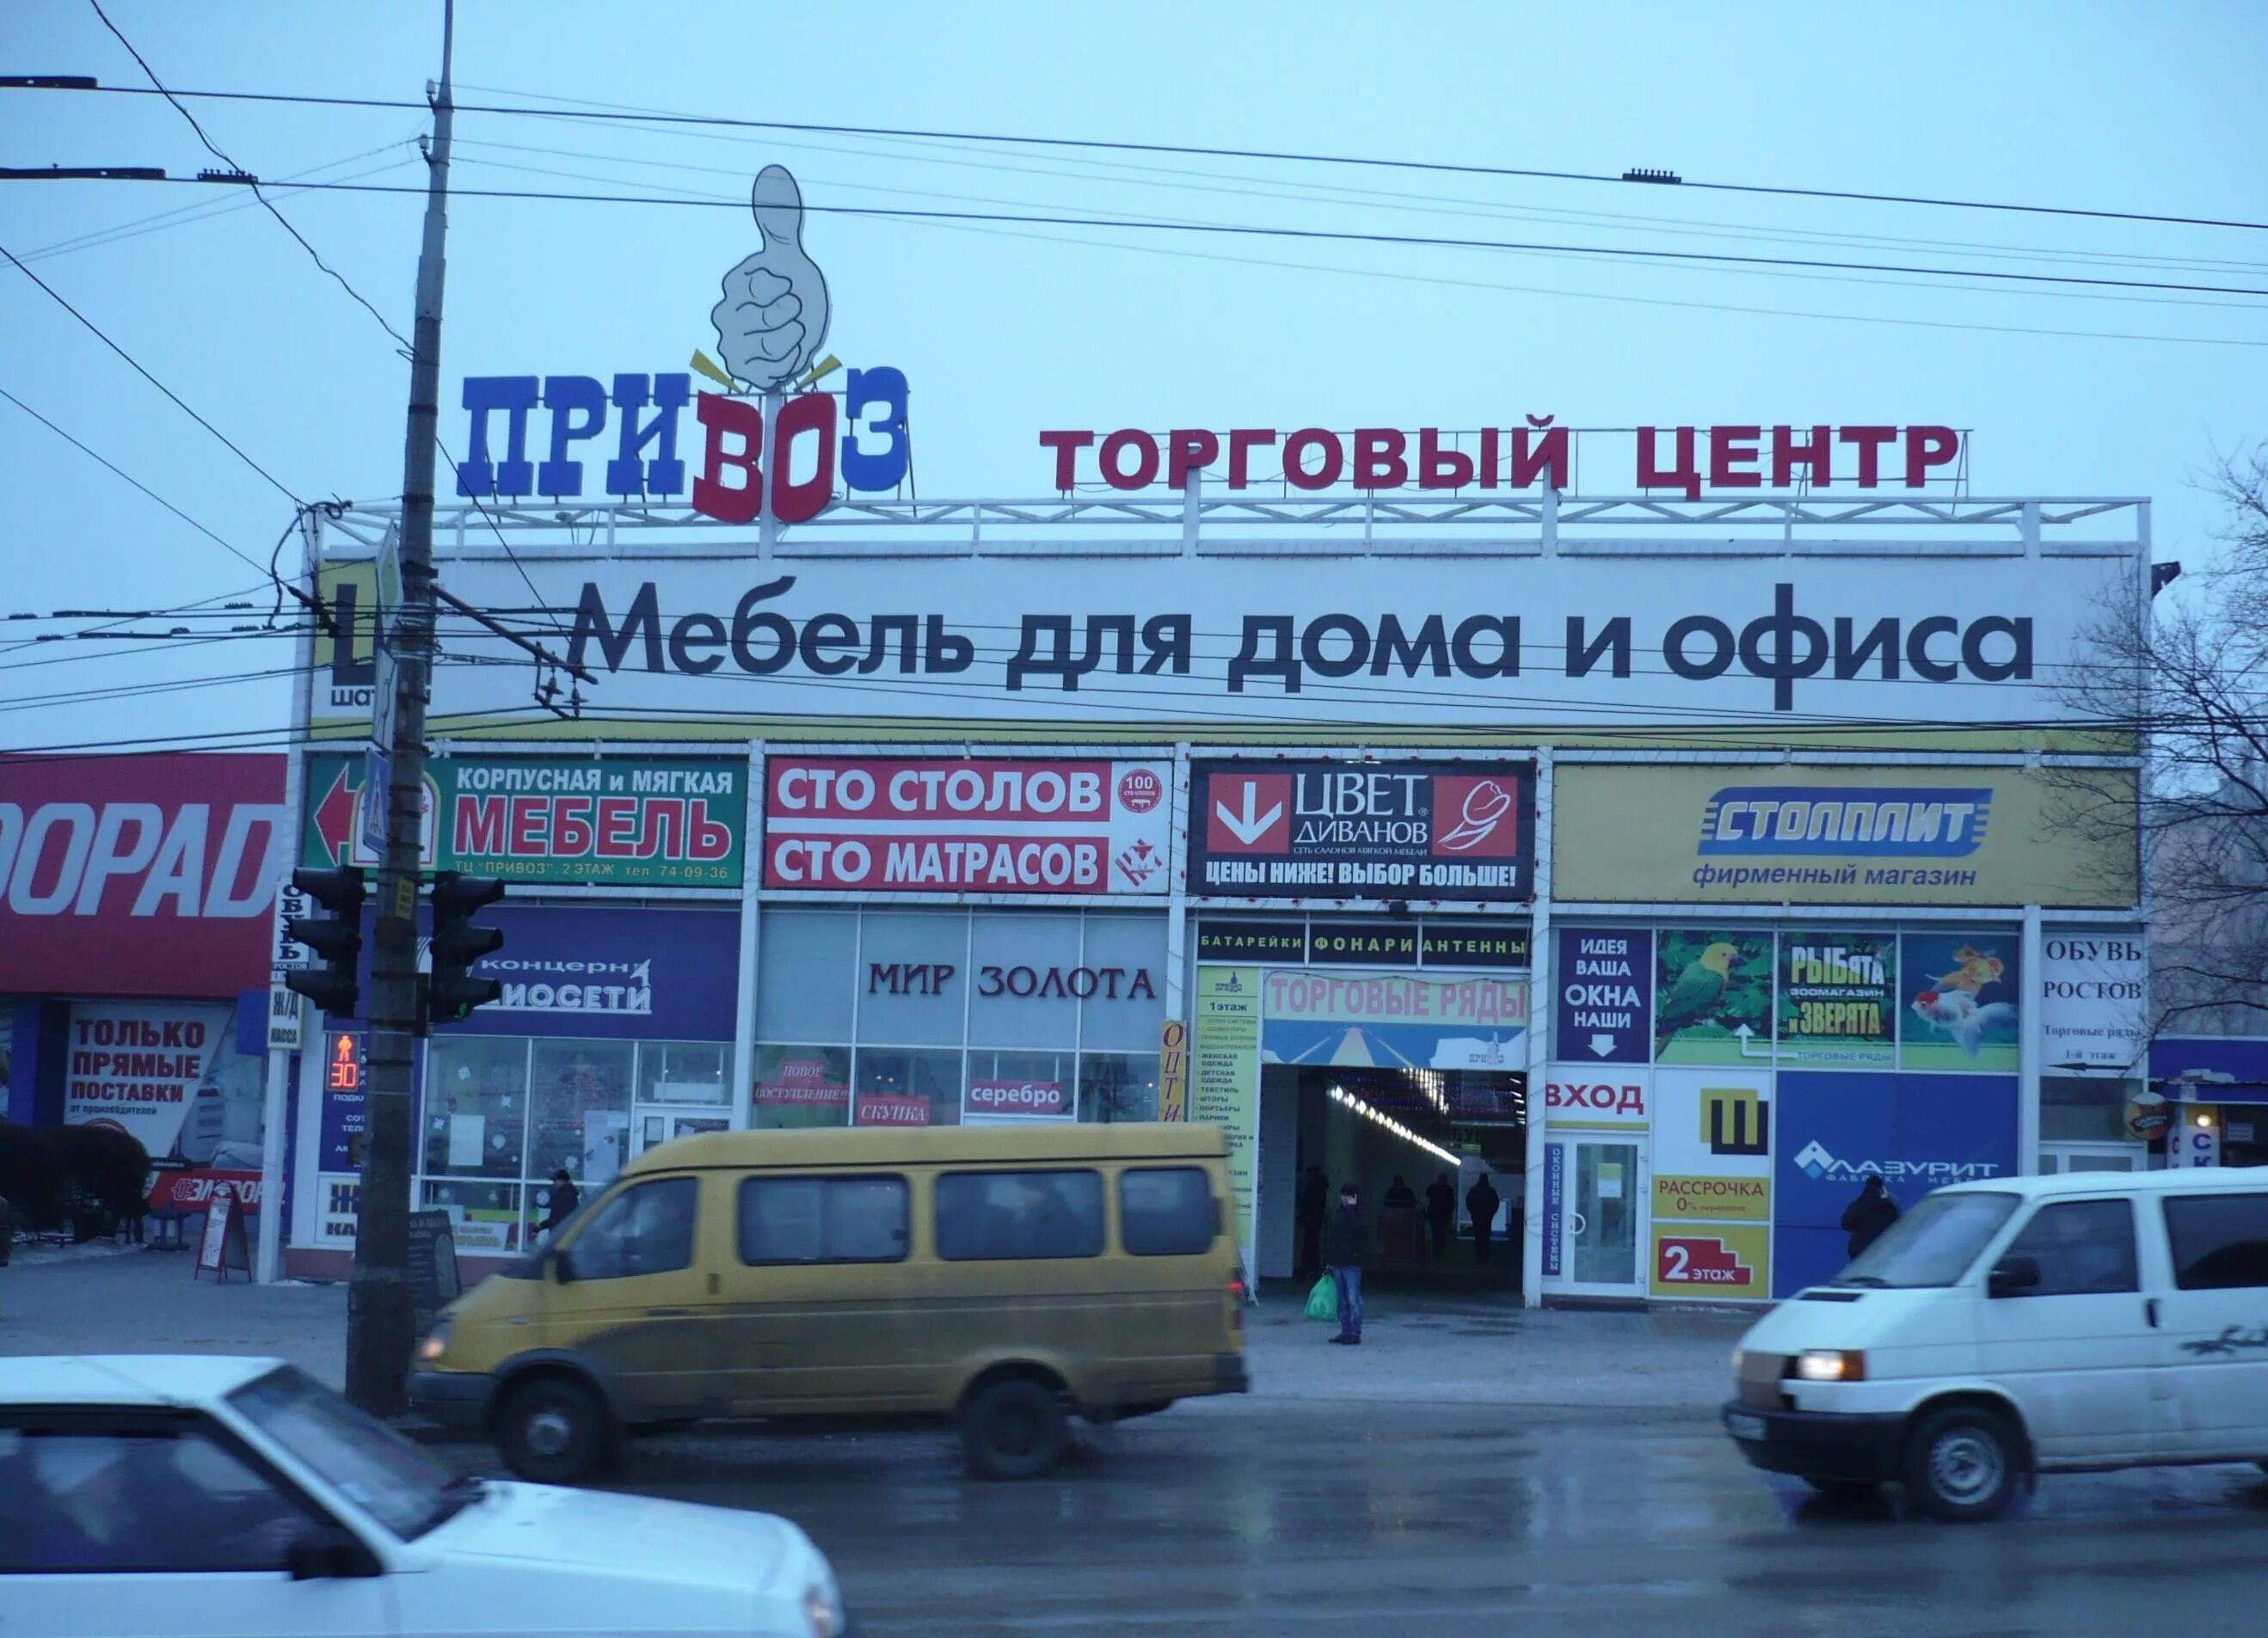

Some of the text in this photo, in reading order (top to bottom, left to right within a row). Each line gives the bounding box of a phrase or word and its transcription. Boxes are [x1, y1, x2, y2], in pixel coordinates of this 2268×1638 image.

[457, 366, 908, 525] ПРИВОЗ
[1040, 414, 1959, 499] ТОРГОВЫЙ ЦЕНТР
[569, 576, 2033, 711] Мебель для дома и офиса
[458, 767, 733, 794] КОРПУСНАЯ и МЯГКАЯ
[778, 768, 1102, 813] СТО СТОЛОВ
[1126, 776, 1153, 789] 100
[1294, 772, 1429, 819] ЦВЕТ
[452, 794, 732, 861] МЕБЕЛЬ
[1294, 820, 1429, 845] ДИВАНОВ
[1716, 801, 1975, 843] СТОЛПЛИТ
[0, 802, 288, 917] ОРАД
[774, 839, 1098, 886] СТО МАТРАСОВ
[1294, 846, 1312, 855] СЕТЬ
[1314, 846, 1356, 855] САЛОНОВ
[1394, 847, 1428, 856] МЕБЕЛИ
[454, 861, 474, 875] ТЦ
[563, 863, 571, 874] 2
[575, 863, 615, 875] ЭТАЖ
[661, 865, 729, 879] 74-09-36
[1205, 861, 1516, 887] ЦЕНЫ НИЖЕ! ВЫБОР БОЛЬШЕ!
[1693, 863, 1976, 888] фирменный магазин
[1201, 935, 1526, 954] БАТАРЕЙКИ ФОНАРИ АНТЕННЫ
[1580, 938, 1628, 956] ИДЕЯ
[2046, 940, 2142, 961] ОБУВЬ
[482, 959, 629, 973] концерн
[1576, 960, 1632, 977] ВАША
[1791, 947, 1885, 985] РЫБЯТА
[869, 963, 1156, 1000] МИР ЗОЛОТА
[1790, 987, 1885, 997] ЗООМАГАЗИН
[2044, 980, 2142, 999] РОСТОВ
[273, 991, 299, 1020] Ж/Д
[487, 982, 652, 1011] ИОСЕТИ
[1270, 978, 1527, 1025] ТОРГОВЫЕ РЯДЫ
[1564, 984, 1641, 1008] ОКНА
[1573, 1010, 1632, 1028] НАШИ
[1799, 1001, 1882, 1034] ЗВЕРЯТА
[75, 1018, 206, 1049] ТОЛЬКО
[270, 1028, 298, 1044] КАССА
[2044, 1024, 2105, 1038] Торговые
[72, 1051, 201, 1079] ПРЯМЫЕ
[1798, 1052, 1891, 1062] ТОРГОВЫЕ РЯДЫ
[330, 1063, 358, 1087] 30
[71, 1080, 184, 1102] ПОСТАВКИ
[970, 1085, 1061, 1109] серебро
[1545, 1083, 1644, 1114] ВХОД
[83, 1104, 157, 1115] производителей
[860, 1105, 925, 1121] СКУПКА
[1825, 1174, 1906, 1184] ФАБРКА
[1826, 1159, 2000, 1177] ЛАЗУРИТ
[1659, 1180, 1764, 1196] РАССРОЧКА
[1664, 1245, 1736, 1281] 2 этаж
